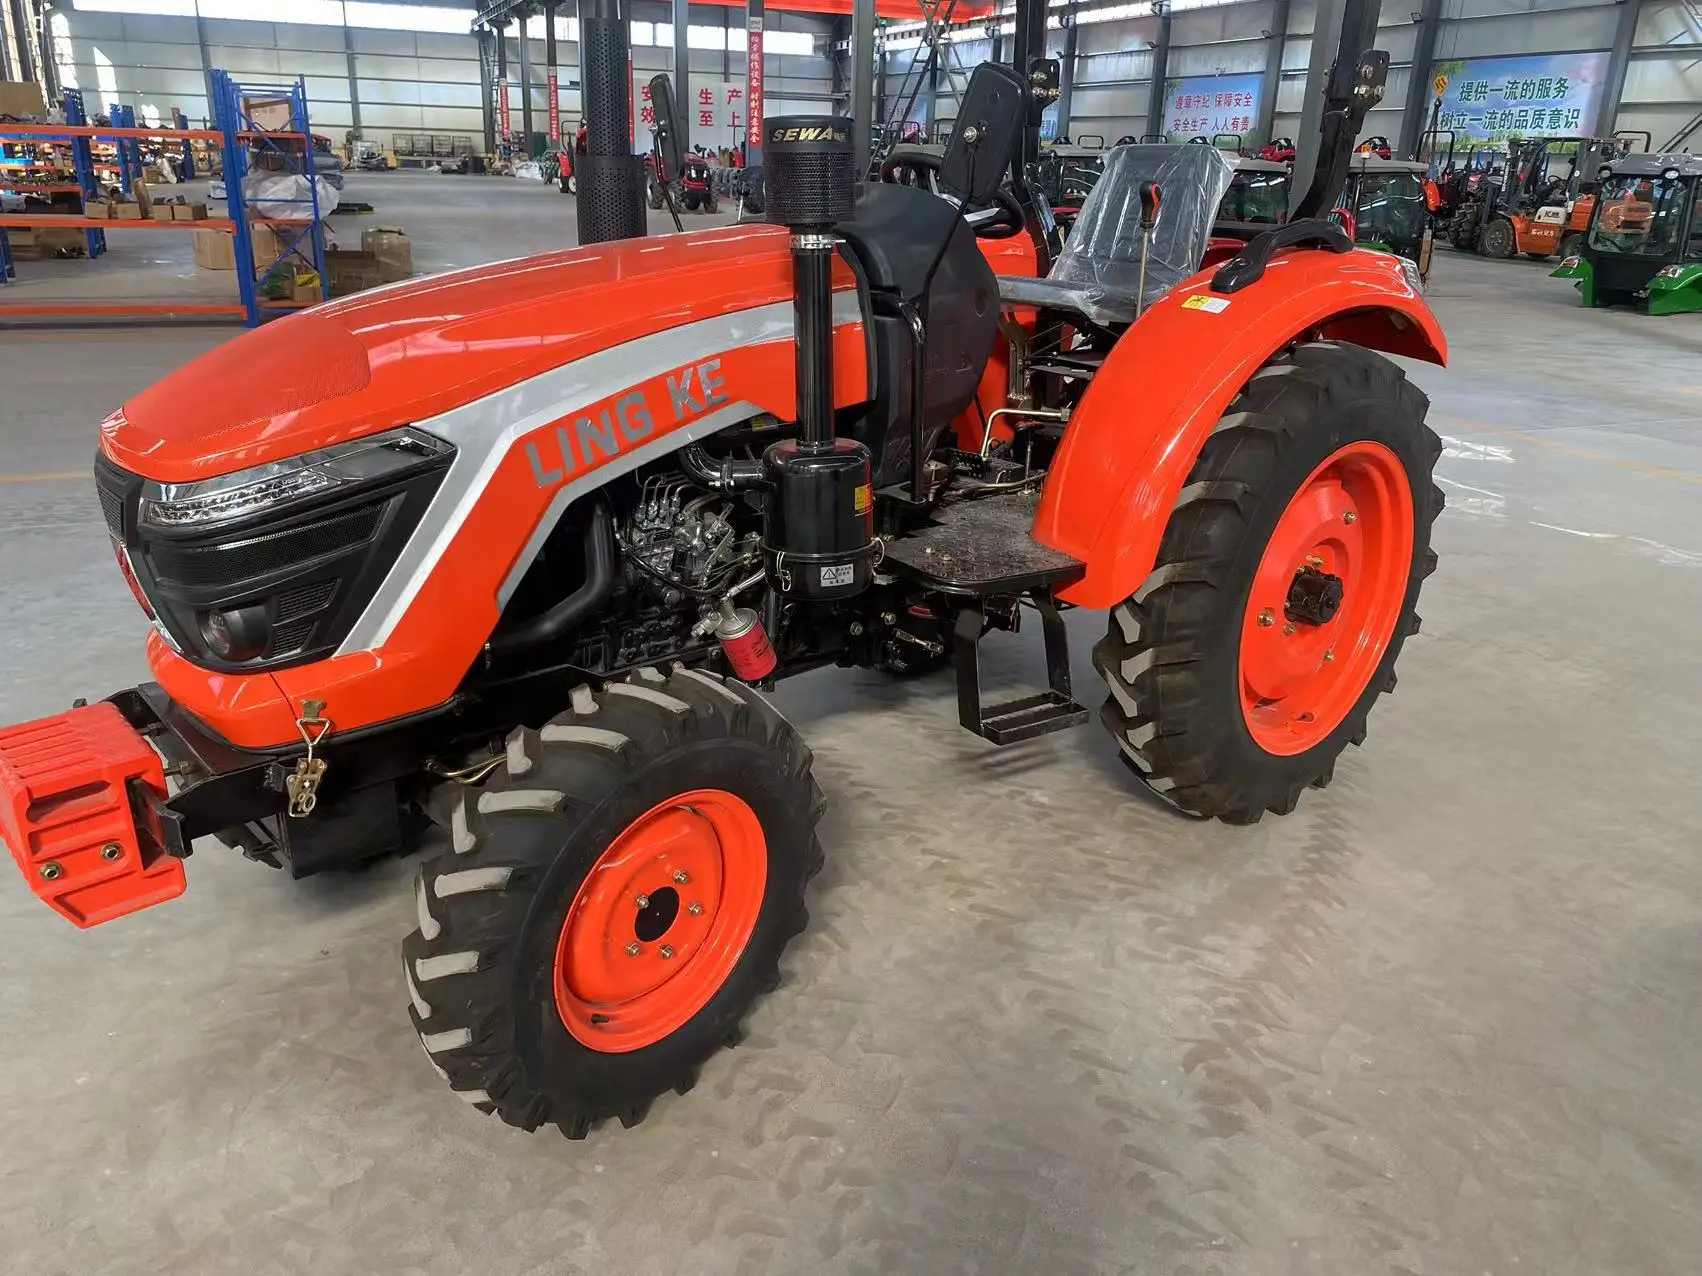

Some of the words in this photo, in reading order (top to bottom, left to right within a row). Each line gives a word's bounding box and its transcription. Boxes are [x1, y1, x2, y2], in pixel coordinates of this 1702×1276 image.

[1459, 77, 1569, 101] 提供一流的服务
[1175, 95, 1210, 110] 遵章守纪
[1215, 92, 1252, 107] 保障安全
[1173, 118, 1208, 132] 安全生产
[1211, 115, 1250, 131] 人人有责
[1440, 108, 1580, 130] 树立一流的品质意识
[525, 391, 654, 488] LING
[666, 358, 730, 421] KE
